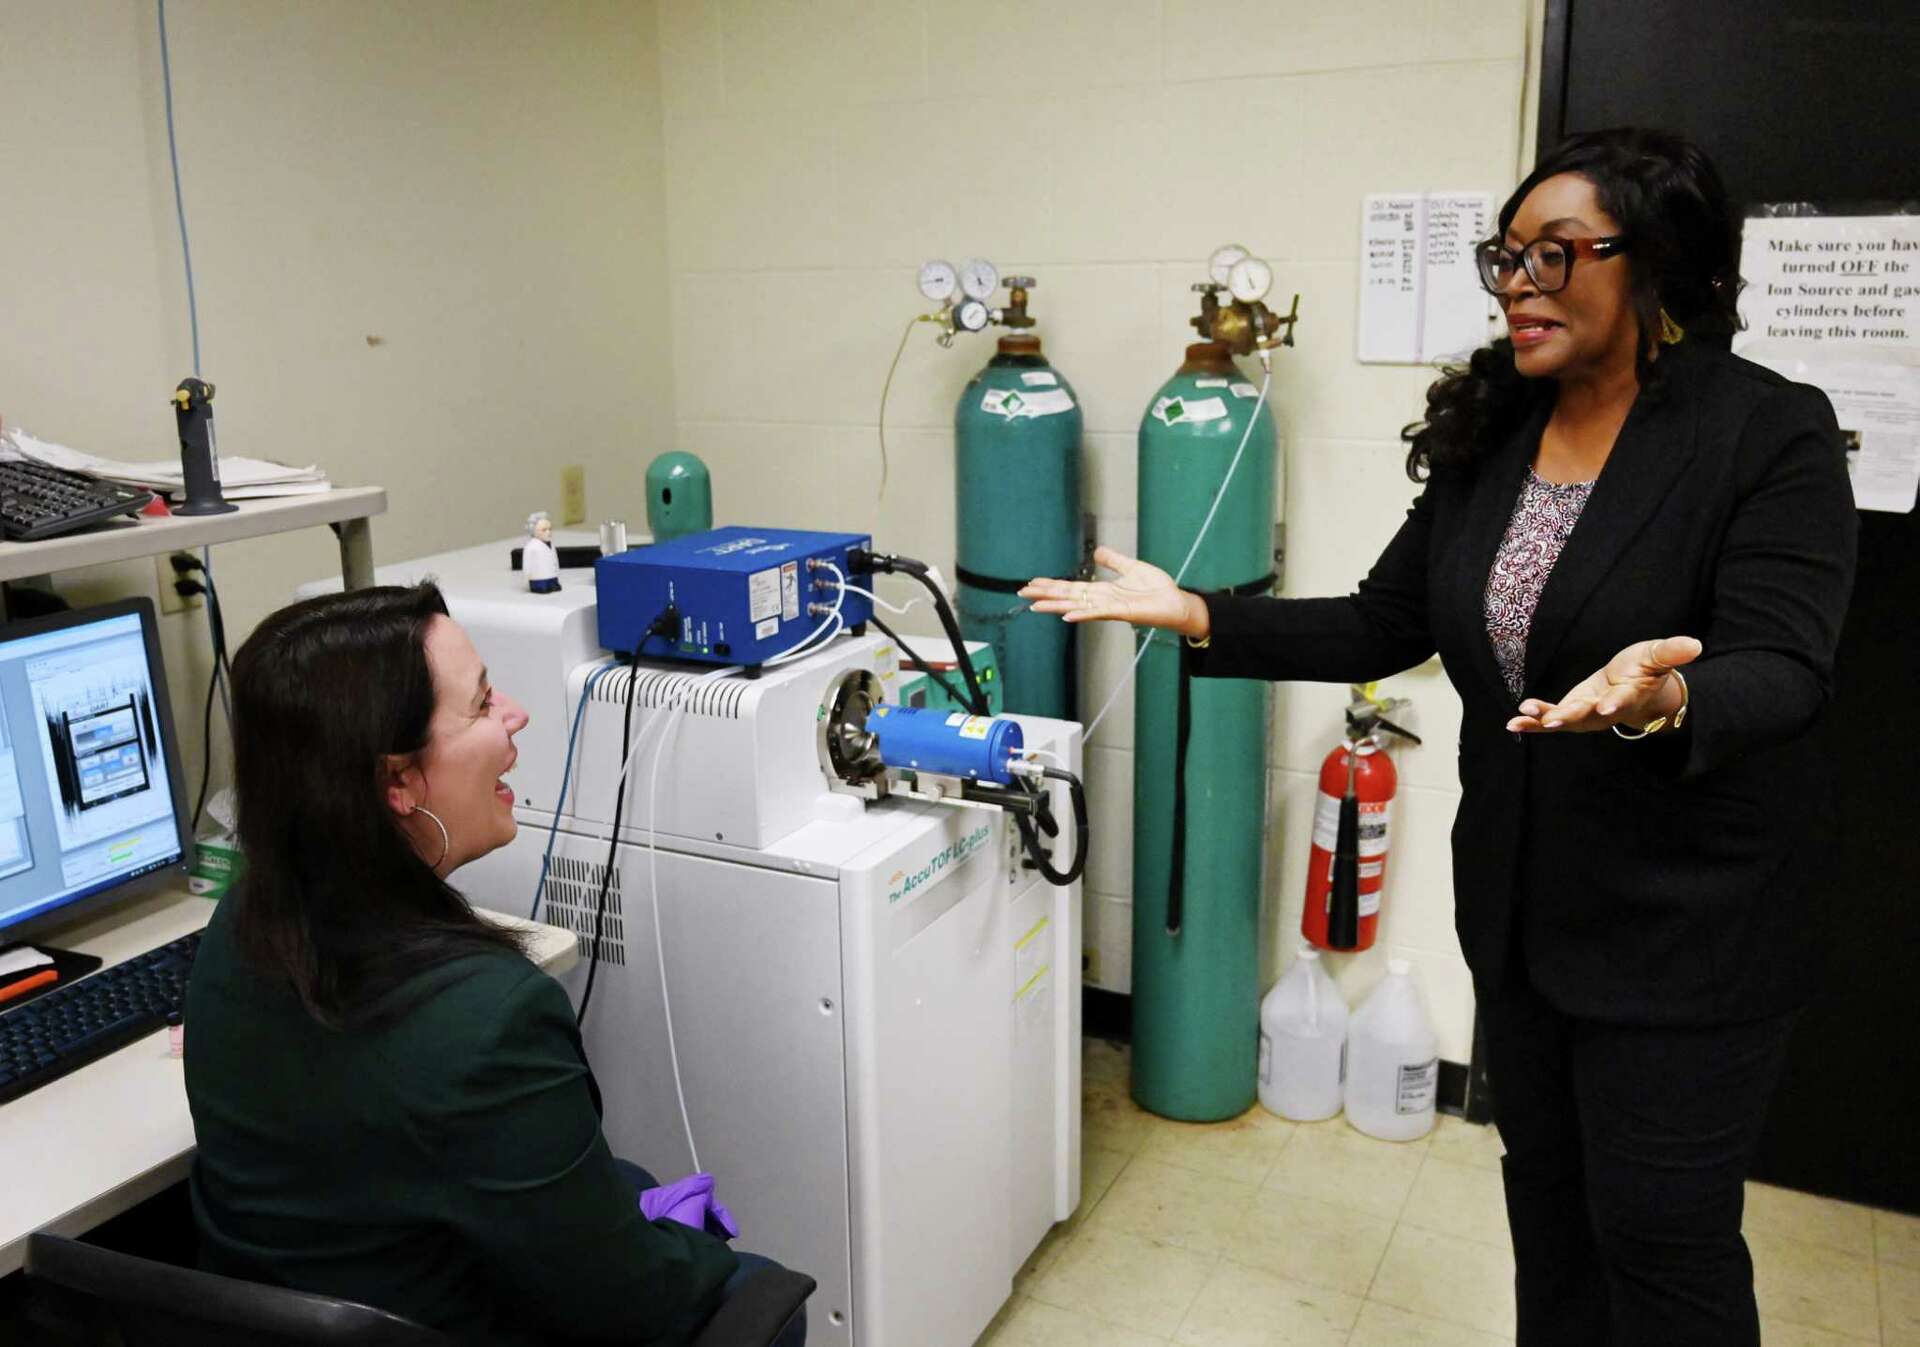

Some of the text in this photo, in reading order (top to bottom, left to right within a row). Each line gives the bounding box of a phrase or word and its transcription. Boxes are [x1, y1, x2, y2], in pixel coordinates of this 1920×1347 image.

[1768, 239, 1812, 252] Make
[1817, 242, 1852, 252] sure
[1856, 241, 1885, 255] you
[1782, 260, 1910, 274] turned OFF the
[1767, 283, 1920, 298] Ion Source and gas
[1776, 304, 1905, 319] cylinders before
[1767, 325, 1910, 339] leaving this room.
[903, 846, 953, 895] AccuTOF
